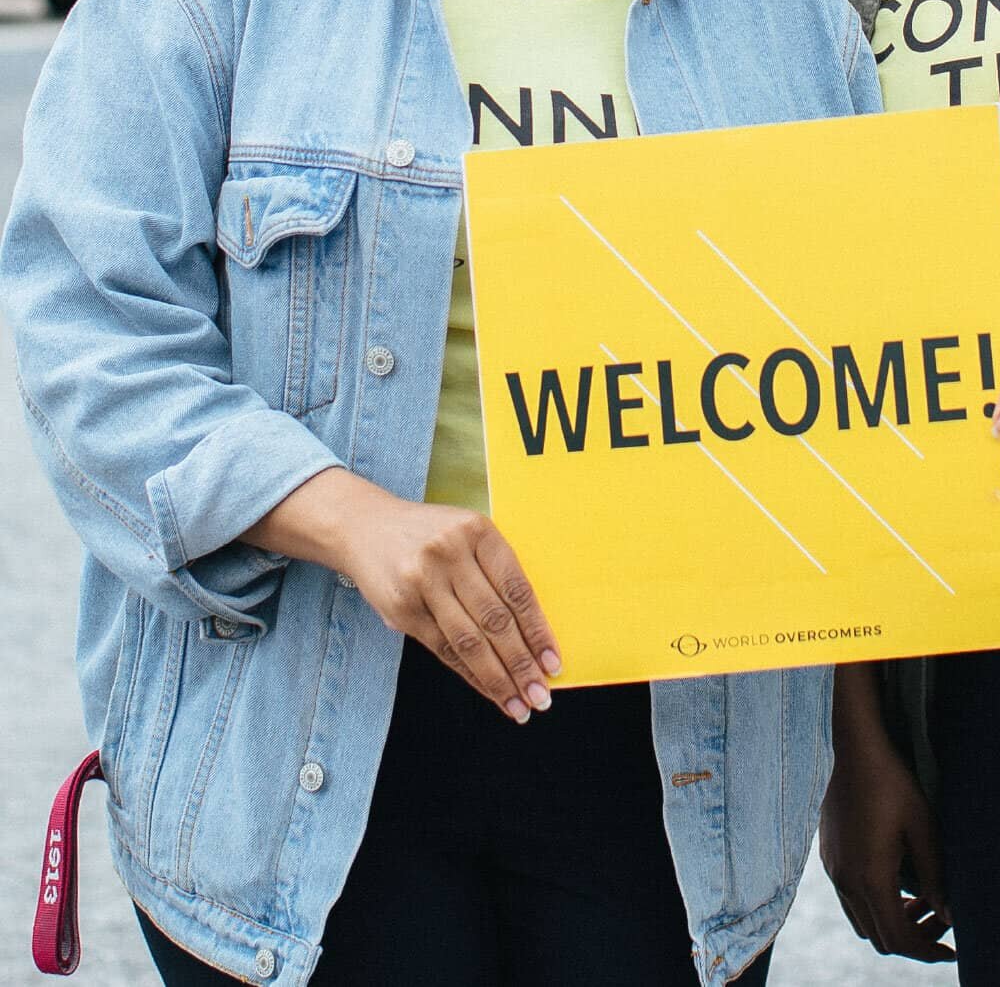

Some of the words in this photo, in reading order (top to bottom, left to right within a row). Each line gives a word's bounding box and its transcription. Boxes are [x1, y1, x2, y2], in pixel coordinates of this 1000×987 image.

[468, 82, 641, 146] NN
[504, 332, 996, 456] WELCOME!
[712, 634, 769, 649] WORLD
[774, 624, 883, 644] OVERCOMERS
[43, 829, 62, 905] 1913
